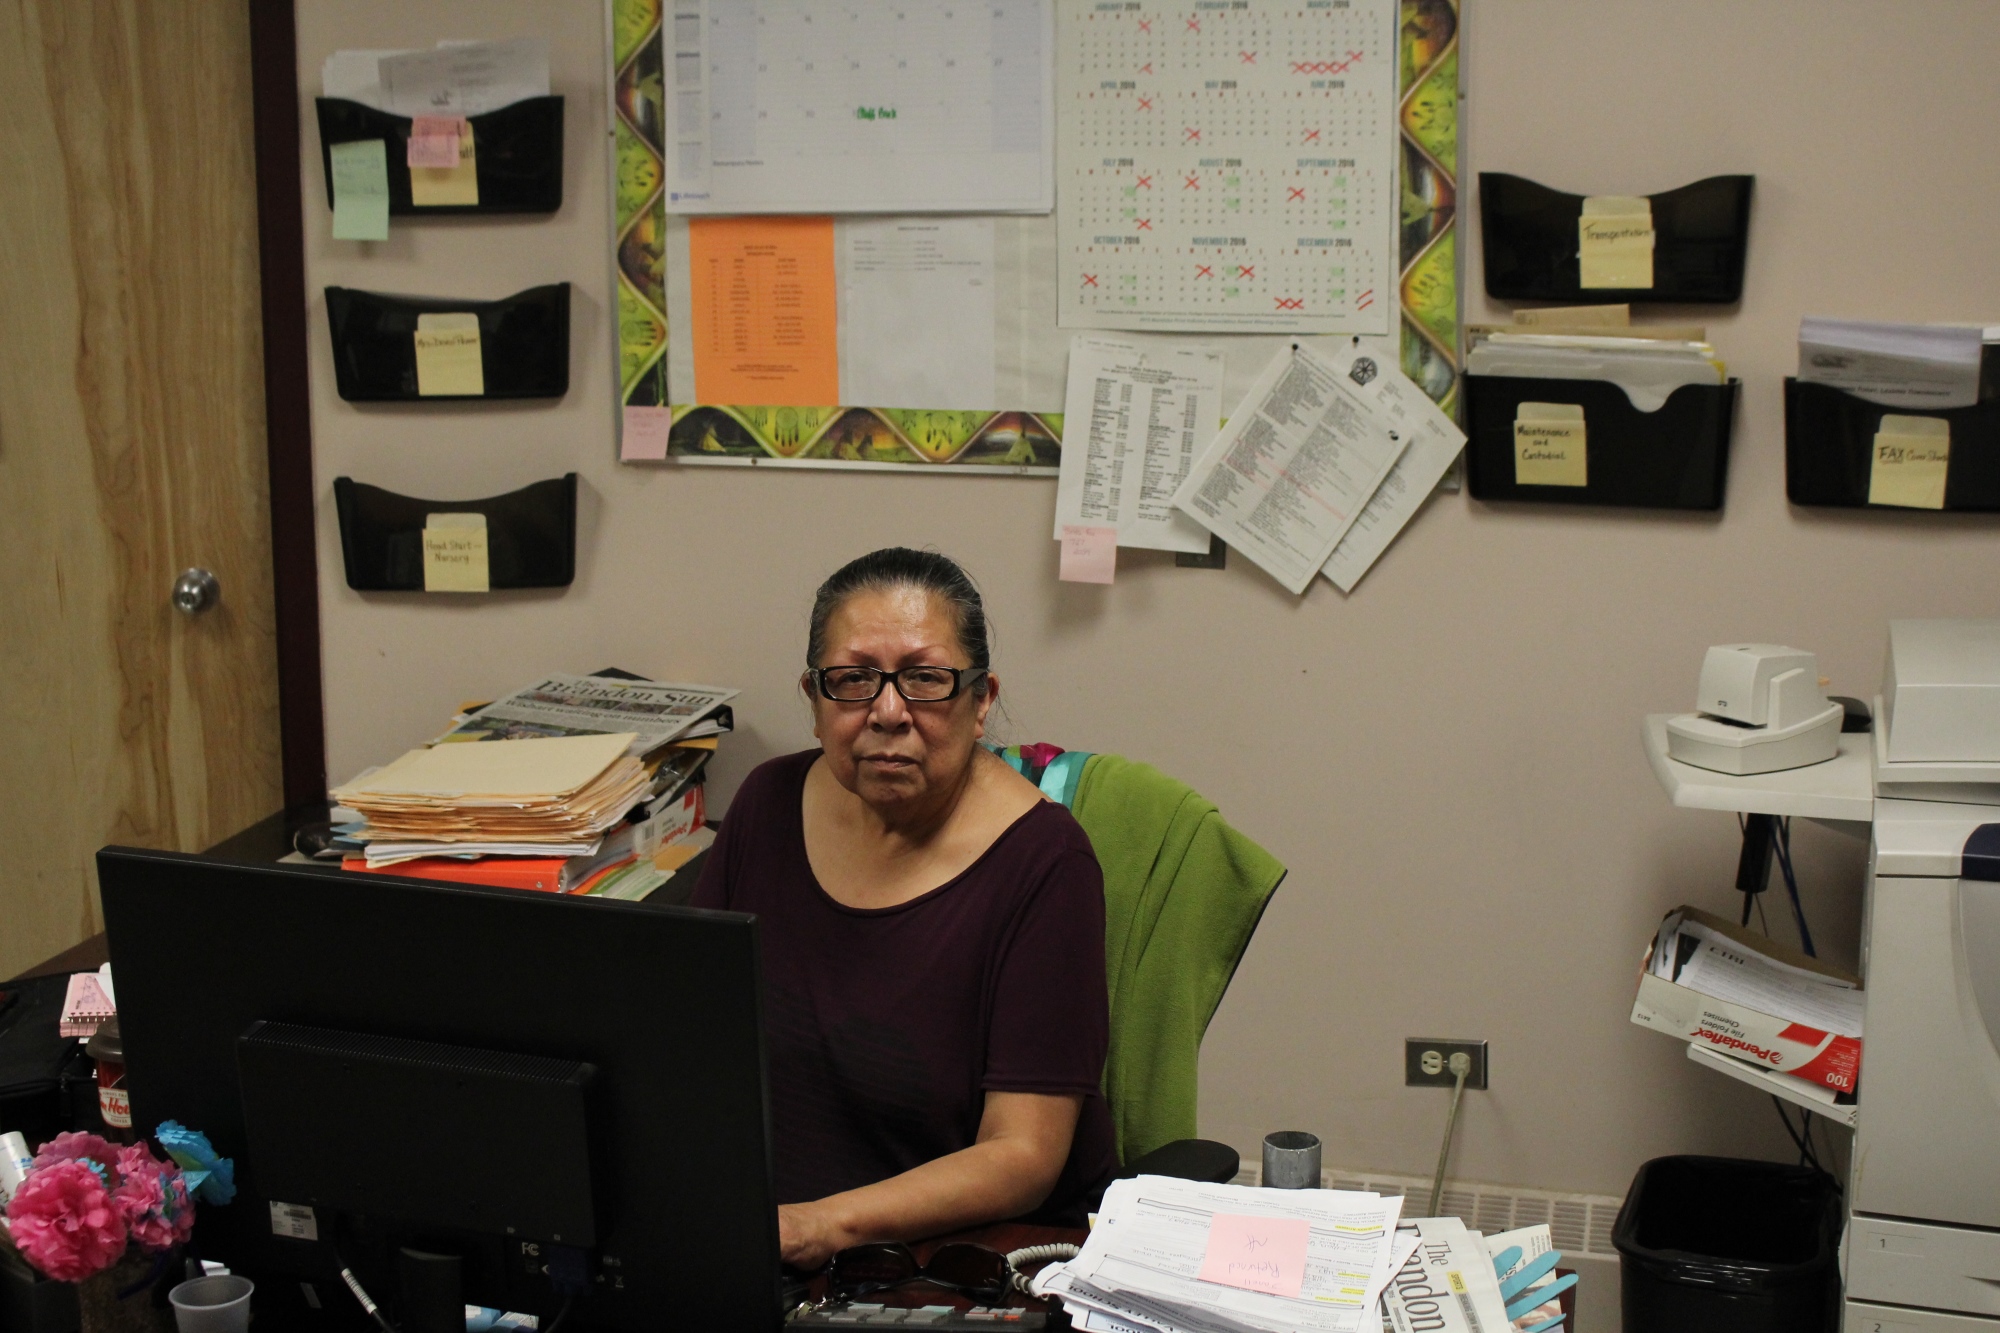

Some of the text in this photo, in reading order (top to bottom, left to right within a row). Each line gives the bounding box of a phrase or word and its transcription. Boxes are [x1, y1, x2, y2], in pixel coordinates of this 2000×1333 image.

[1118, 159, 1134, 167] 2016
[1225, 159, 1242, 167] 2016
[1338, 159, 1355, 168] 2016
[1124, 236, 1140, 245] 2016
[1230, 237, 1247, 246] 2016
[1335, 238, 1352, 247] 2016
[1878, 445, 1904, 460] FAX
[425, 539, 447, 551] Head
[434, 552, 470, 565] Nursery
[534, 680, 715, 705] Brandon Sun
[1703, 1011, 1740, 1028] Chemises
[1700, 1019, 1745, 1039] File Folders
[1689, 1027, 1771, 1060] Pendaflex
[1826, 1072, 1849, 1089] 100
[1880, 1239, 1886, 1248] 1
[1424, 1240, 1452, 1266] The
[1451, 1274, 1463, 1290] SPORTS
[1068, 1285, 1120, 1310] SCHOOL
[1874, 1323, 1881, 1333] 2
